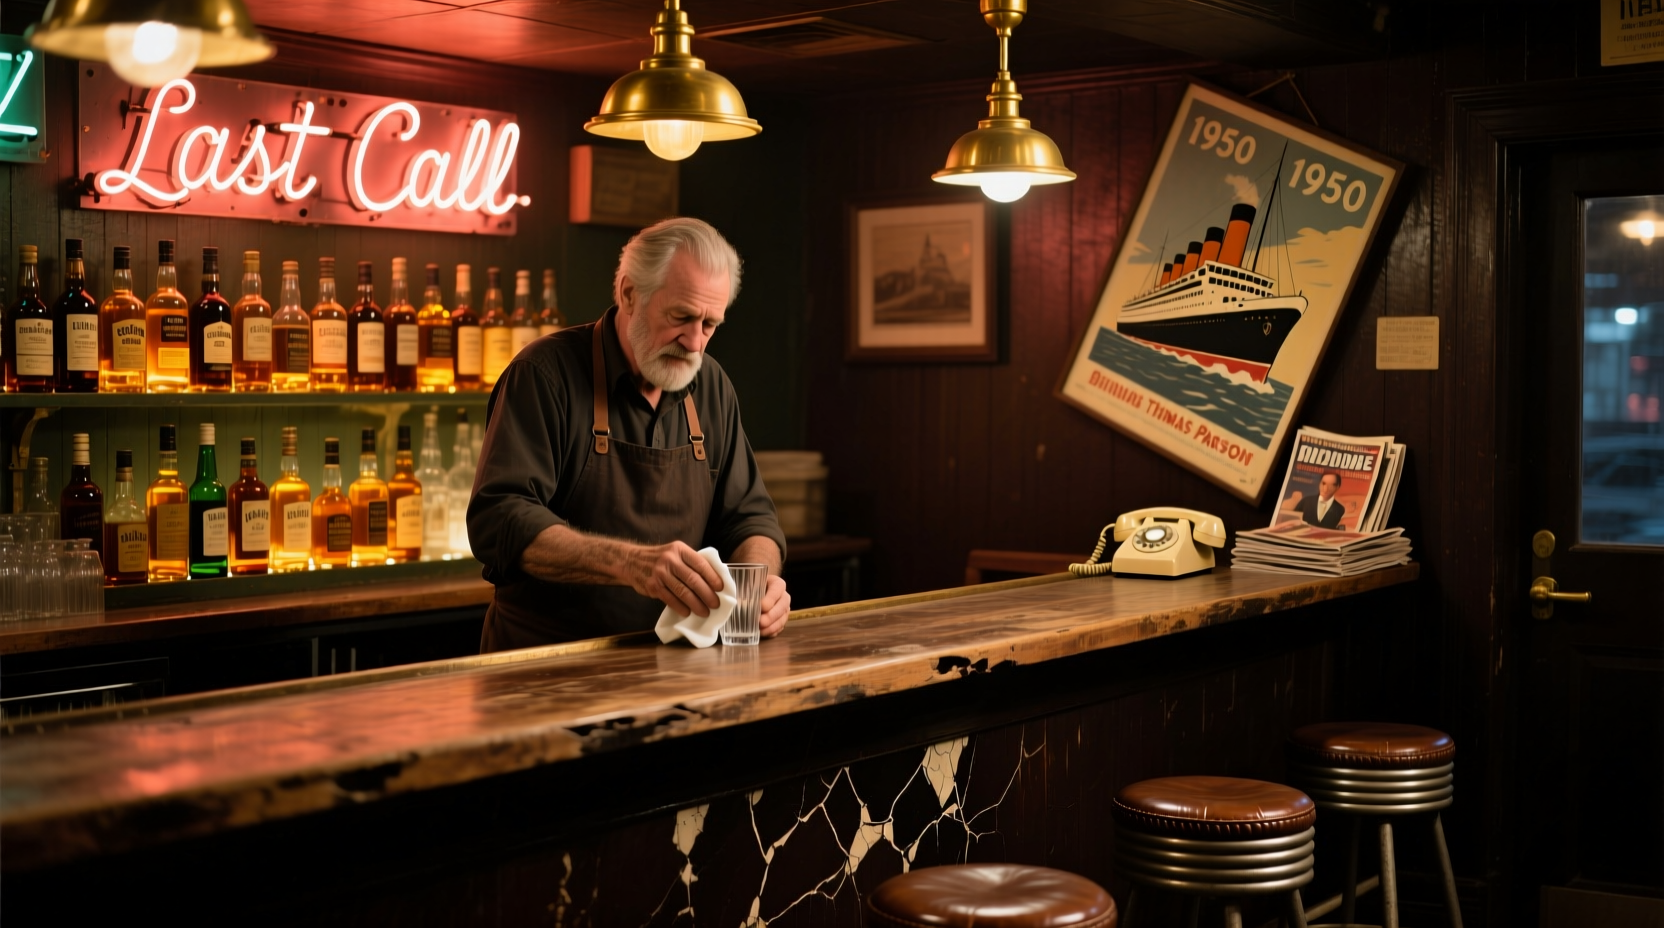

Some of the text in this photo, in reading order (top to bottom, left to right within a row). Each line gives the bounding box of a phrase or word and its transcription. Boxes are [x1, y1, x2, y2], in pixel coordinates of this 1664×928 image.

[99, 79, 332, 202] Last
[1188, 115, 1367, 213] 1950 1950
